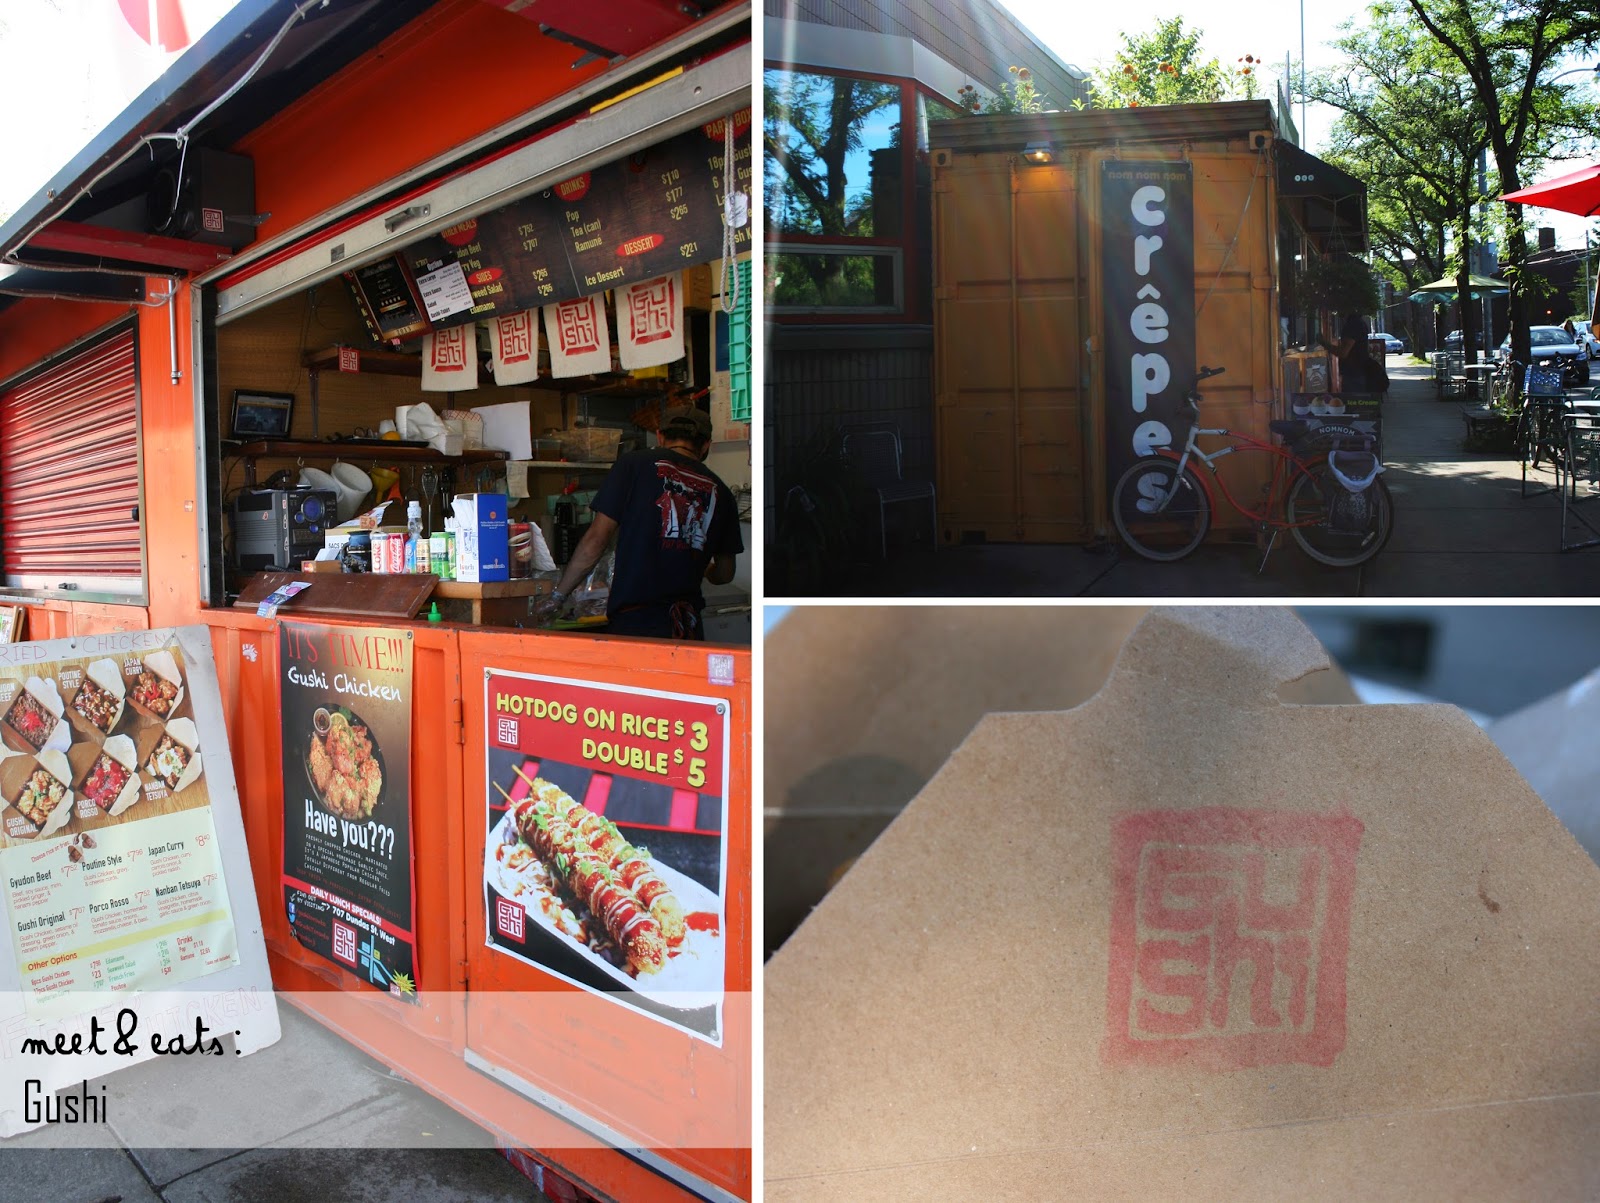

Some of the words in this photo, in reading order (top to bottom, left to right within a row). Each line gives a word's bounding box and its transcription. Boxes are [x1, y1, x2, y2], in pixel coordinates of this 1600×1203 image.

[706, 117, 730, 138] PART
[1108, 171, 1133, 179] nom
[1163, 172, 1187, 180] nom
[561, 177, 584, 195] DRINKS
[566, 211, 579, 222] Pop
[571, 227, 583, 237] Tea
[584, 219, 601, 234] (can)
[624, 237, 654, 255] DESSERT
[476, 271, 492, 282] SIDES
[585, 276, 596, 286] Ice
[597, 267, 624, 283] Dessert
[1319, 426, 1355, 436] NOMNOM
[0, 645, 47, 663] RIED
[82, 633, 168, 653] CHICKEN
[286, 628, 318, 663] IT'S
[324, 632, 404, 673] TIME!!!
[58, 670, 82, 680] POUTINE
[62, 679, 80, 689] STYLE
[288, 665, 329, 690] Gushi
[334, 673, 402, 702] Chicken
[496, 692, 578, 724] HOTDOG
[583, 707, 615, 731] ON
[622, 713, 669, 741] RICE
[582, 738, 668, 775] DOUBLE
[77, 799, 96, 809] PORCO
[80, 807, 98, 818] ROSSO
[7, 816, 25, 827] GUSHI
[10, 823, 38, 837] ORIGINAL
[305, 799, 337, 838] Have
[341, 820, 394, 860] you???
[148, 846, 166, 856] Japan
[167, 841, 184, 852] Curry
[82, 860, 106, 871] Poutine
[107, 855, 122, 866] Style
[10, 875, 35, 888] Gyudon
[36, 870, 51, 882] Beef
[155, 885, 178, 897] Nanban
[178, 879, 201, 891] Tetsuya
[89, 903, 109, 913] Porco
[110, 897, 129, 908] Rosso
[311, 886, 329, 899] DAILY
[330, 894, 350, 910] LUNCH
[352, 902, 381, 925] SPECIALS!
[18, 918, 37, 932] Gushi
[38, 911, 65, 926] Original
[333, 906, 344, 918] 707
[345, 912, 369, 932] Dundas
[370, 924, 379, 936] St.
[380, 929, 395, 946] West
[177, 935, 192, 946] Drinks
[28, 960, 49, 970] Other
[50, 952, 77, 965] Options
